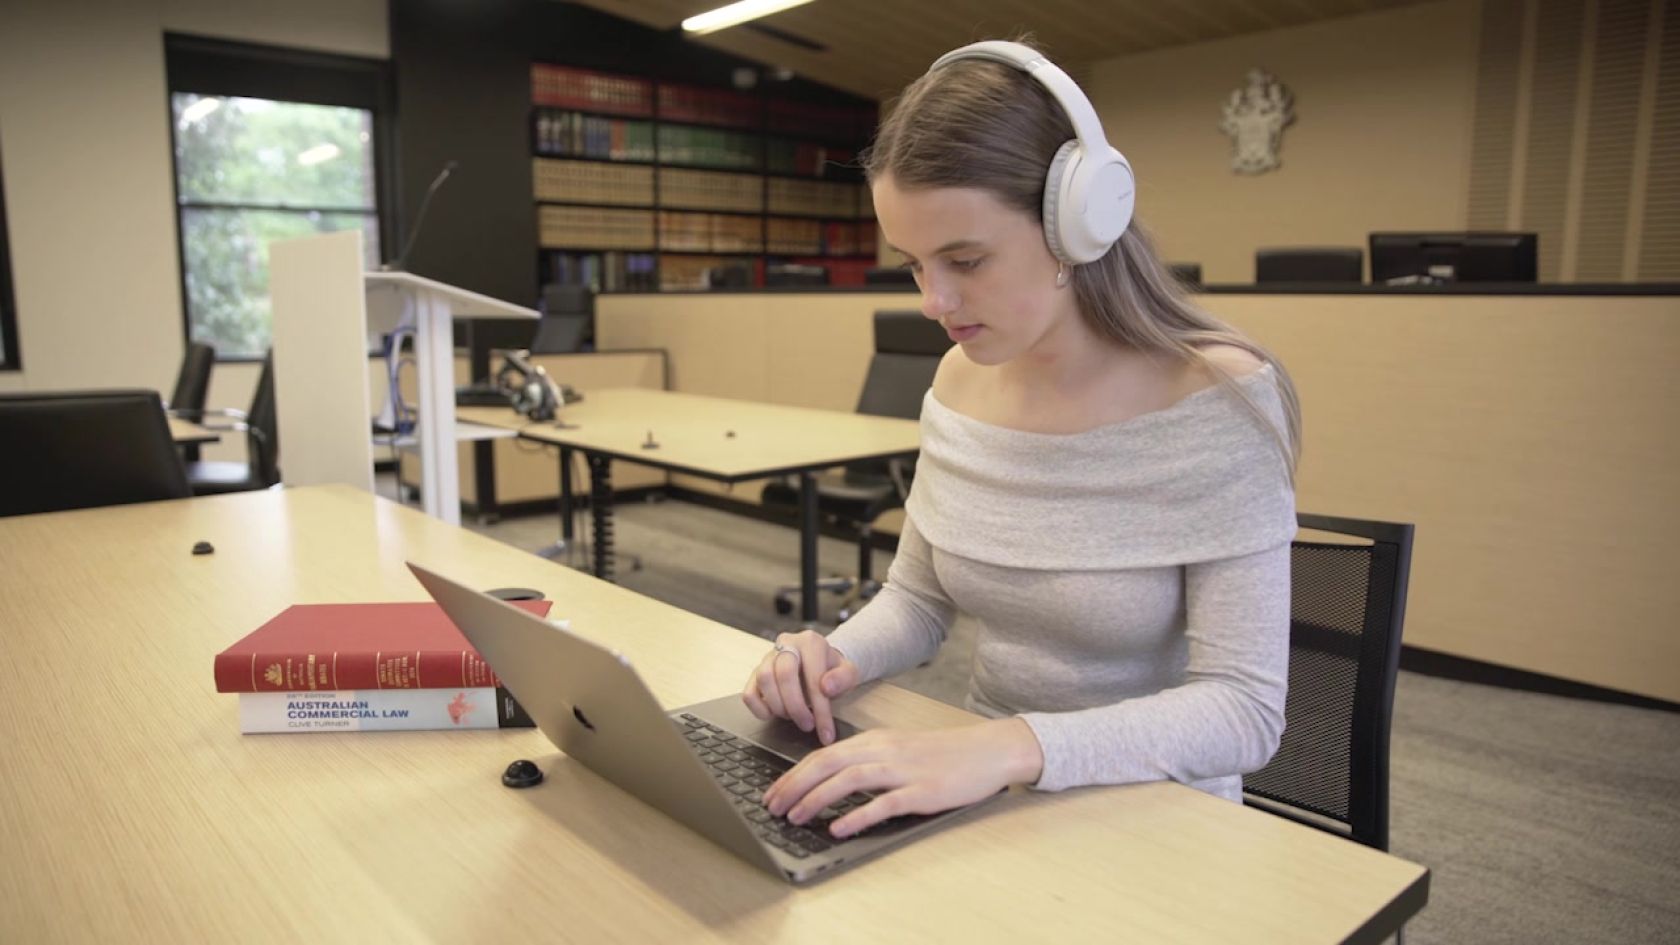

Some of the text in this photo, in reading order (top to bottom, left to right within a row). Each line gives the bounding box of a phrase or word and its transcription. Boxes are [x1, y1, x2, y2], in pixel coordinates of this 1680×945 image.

[287, 701, 369, 710] AUSTRALIAN
[287, 709, 409, 719] COMMERCIAL LAW
